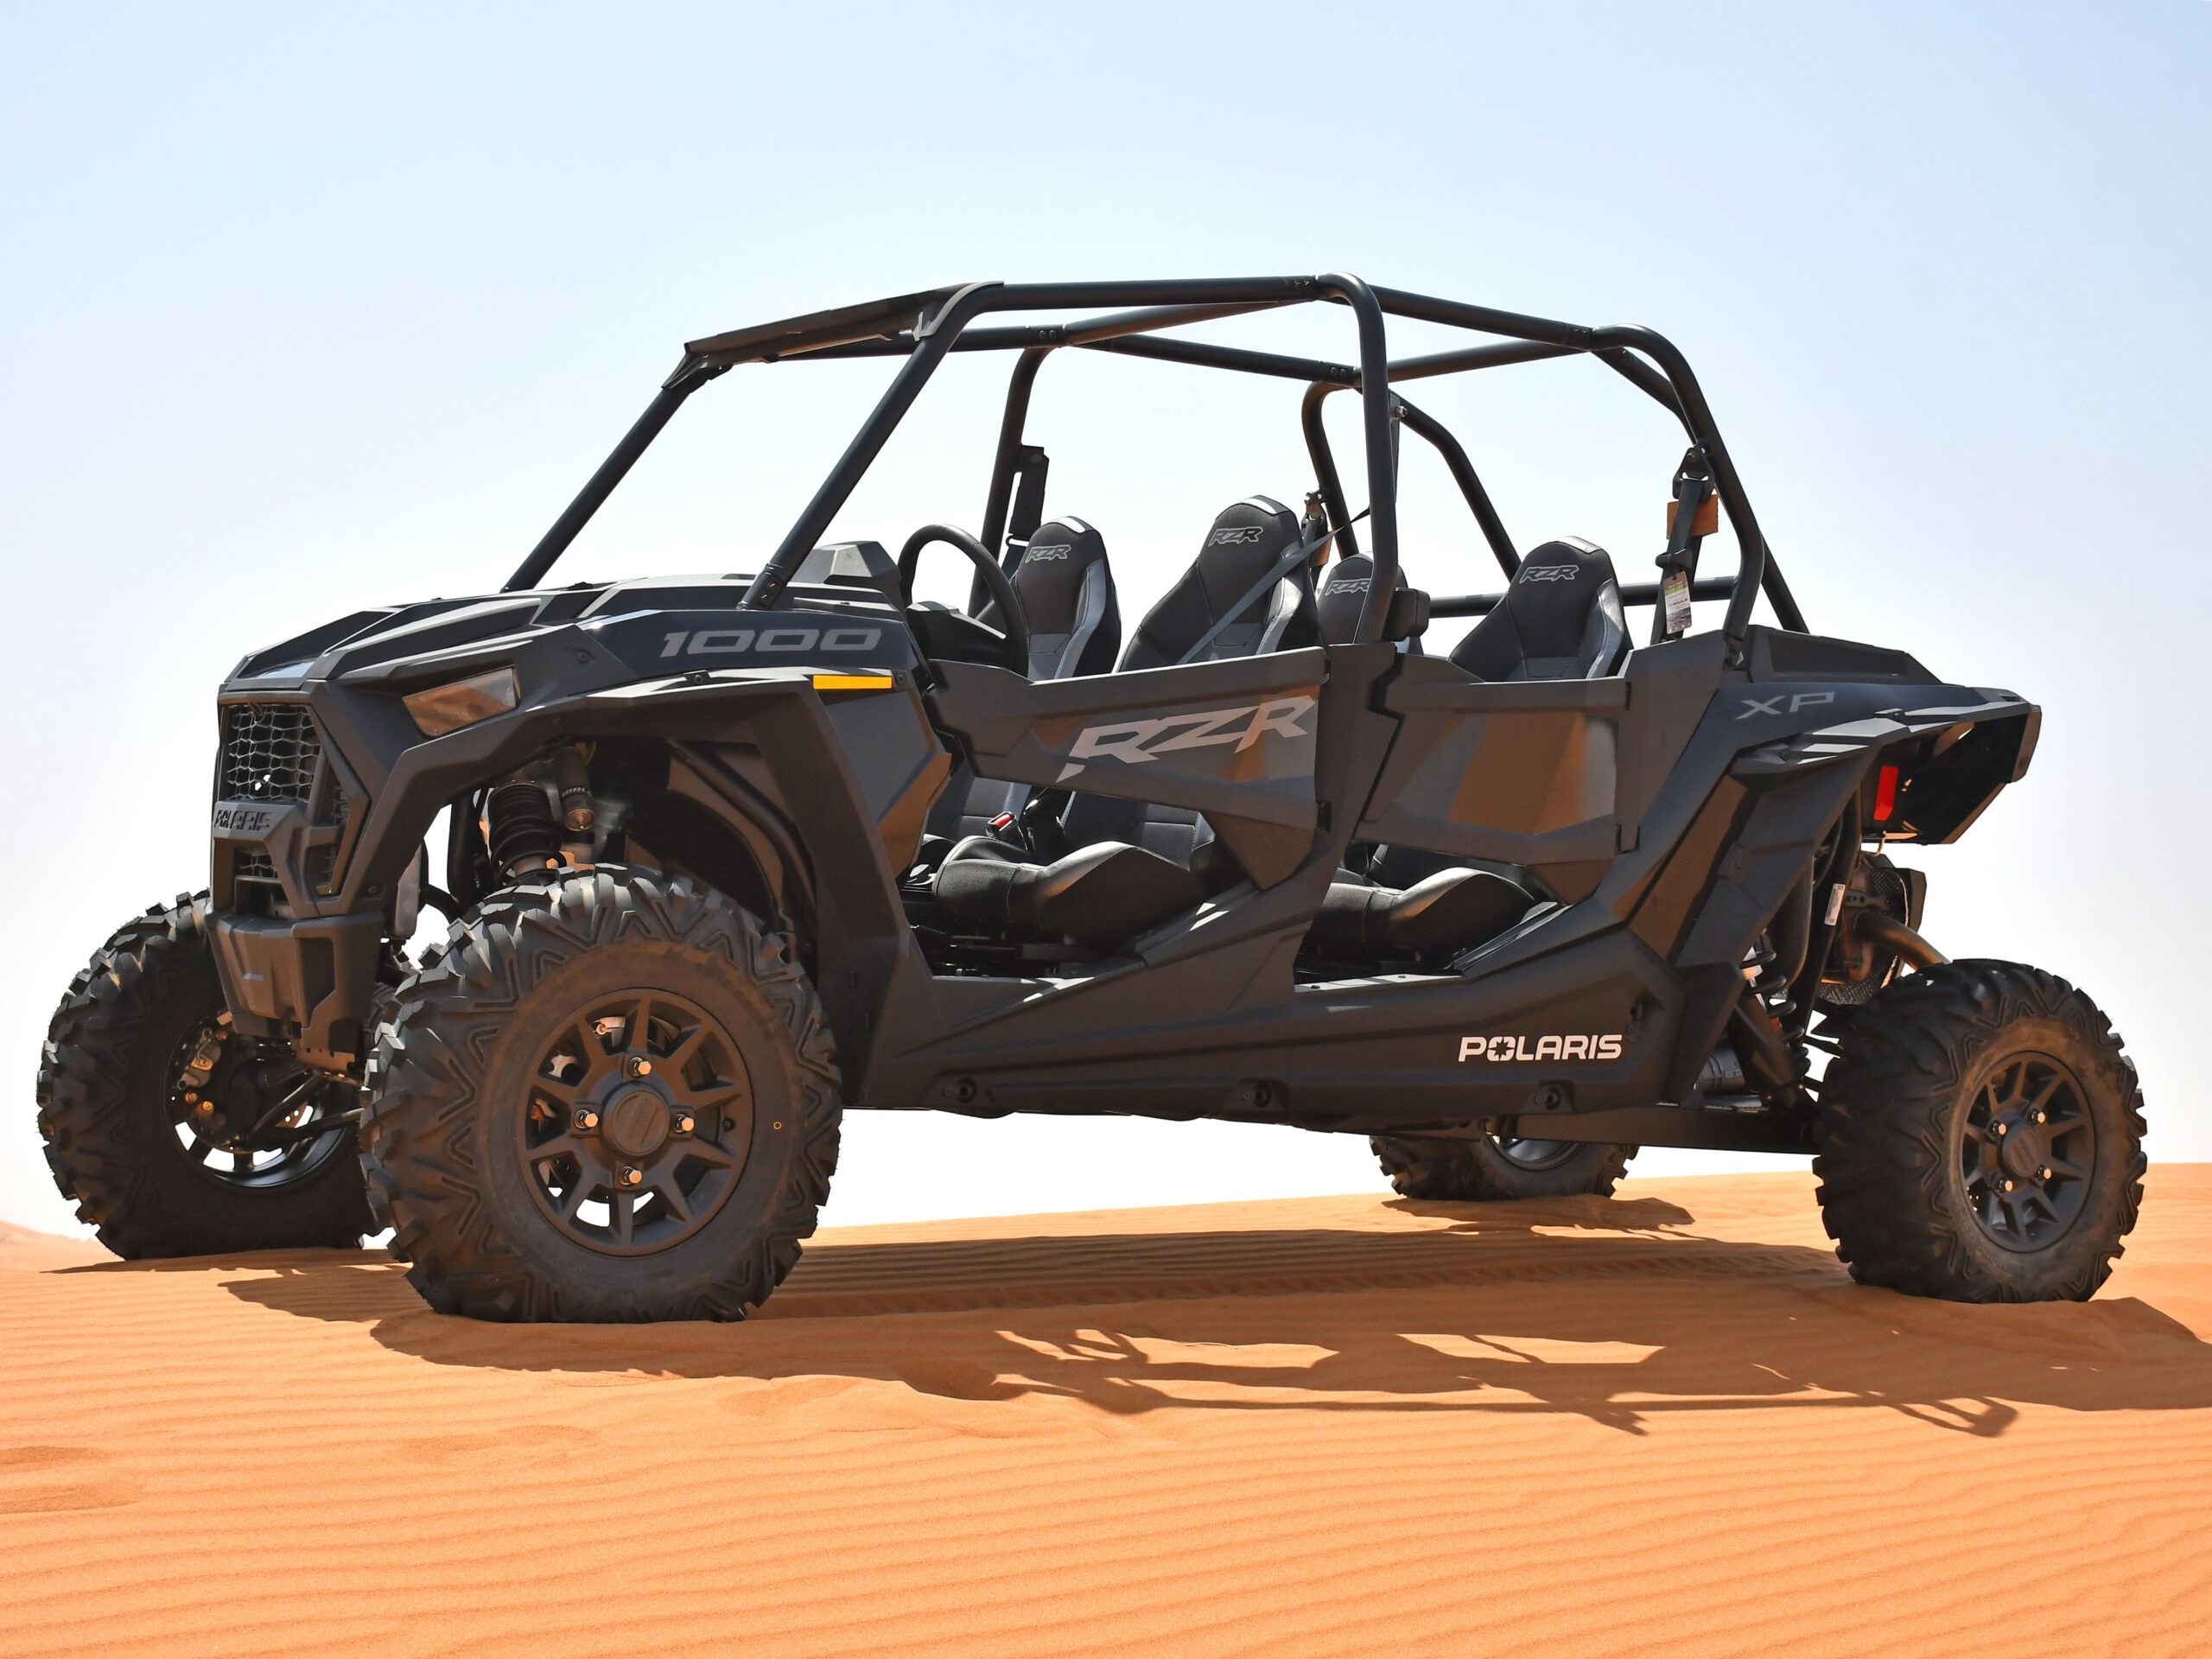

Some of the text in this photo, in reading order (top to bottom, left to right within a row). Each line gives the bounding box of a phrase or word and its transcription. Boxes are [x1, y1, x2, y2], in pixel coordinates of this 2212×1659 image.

[1208, 525, 1263, 547] RZR
[1025, 543, 1071, 563] RZR
[1519, 564, 1580, 584] RZR
[659, 628, 881, 658] 1000
[1735, 691, 1835, 720] XP
[1056, 695, 1315, 783] RZR
[1458, 1034, 1623, 1062] POLARIS
